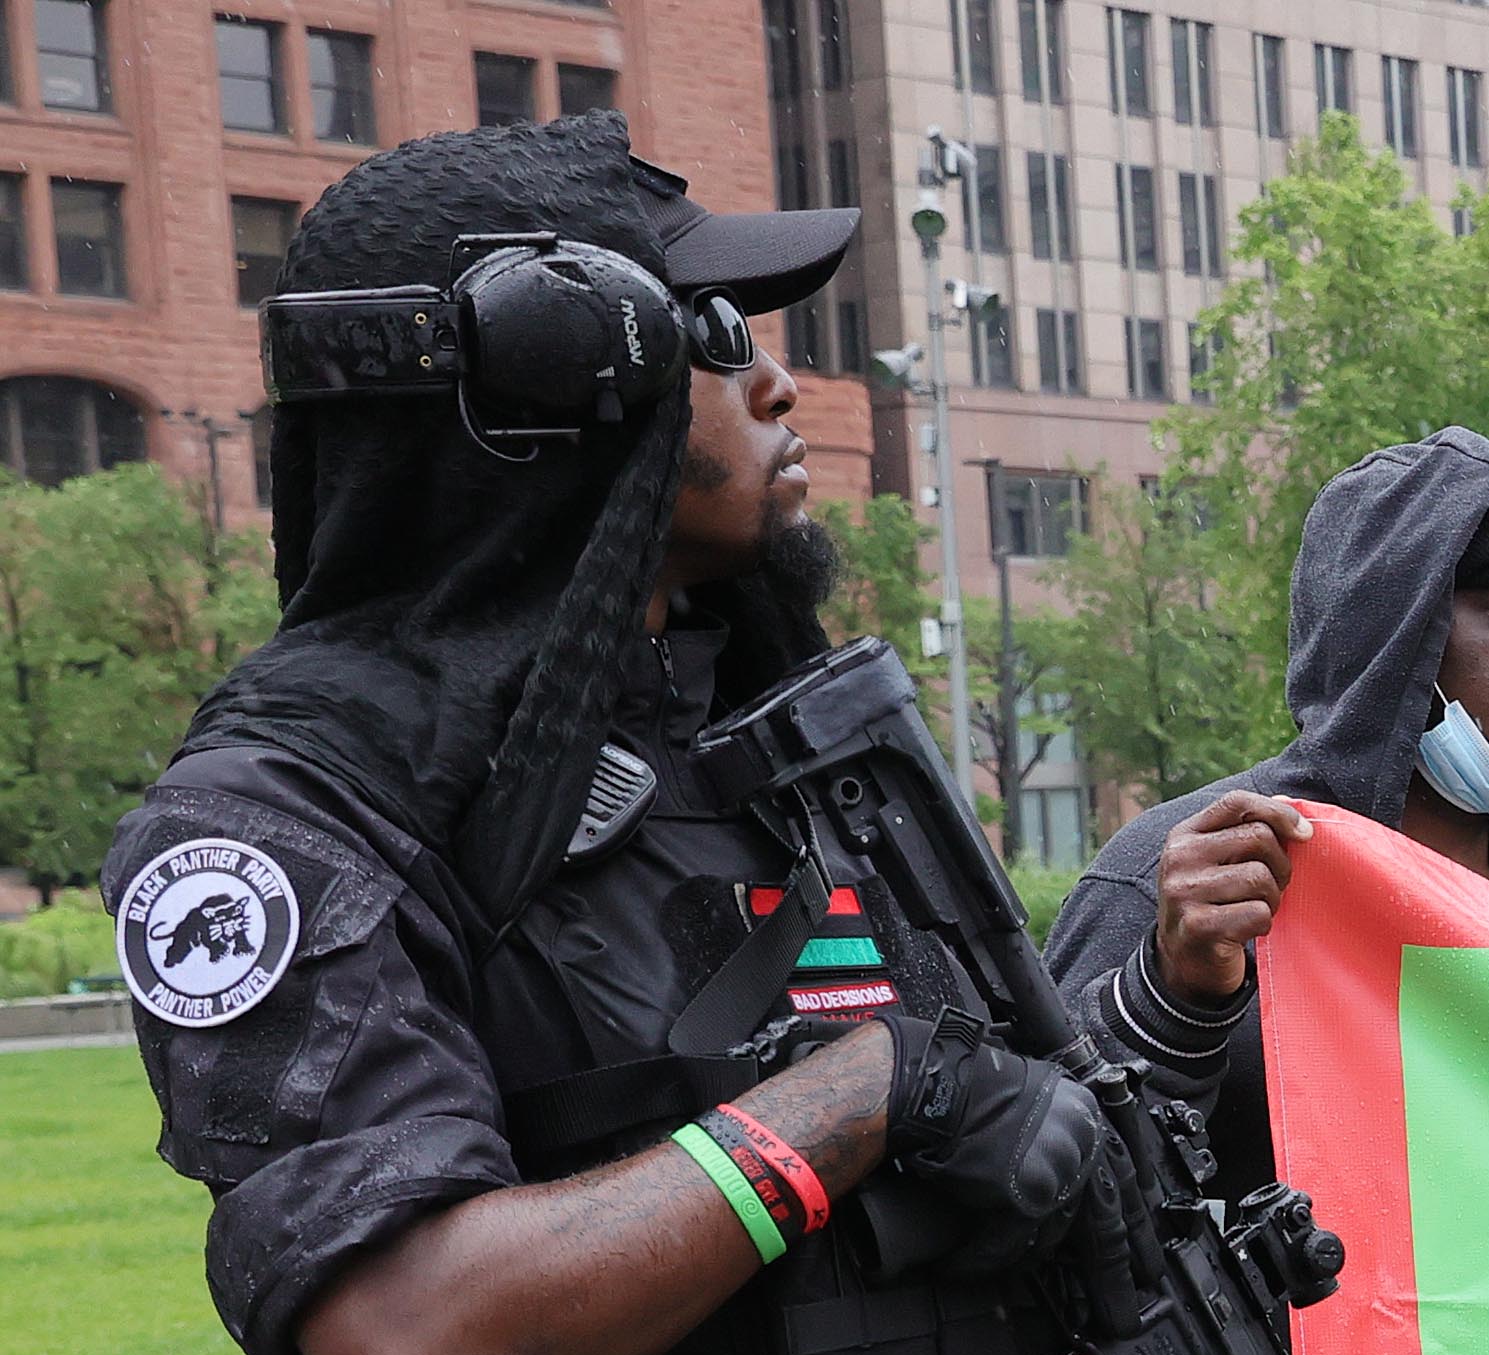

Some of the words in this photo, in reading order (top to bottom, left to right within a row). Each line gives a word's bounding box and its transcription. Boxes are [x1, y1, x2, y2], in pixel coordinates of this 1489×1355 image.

[620, 299, 645, 366] MPOW
[128, 870, 168, 923] BLACK
[169, 849, 241, 876] PANTHER
[242, 861, 284, 901] PARTY
[148, 982, 214, 1018] PANTHER
[221, 966, 272, 1012] POWER
[791, 992, 821, 1010] BAD
[819, 986, 894, 1011] DECISIONS
